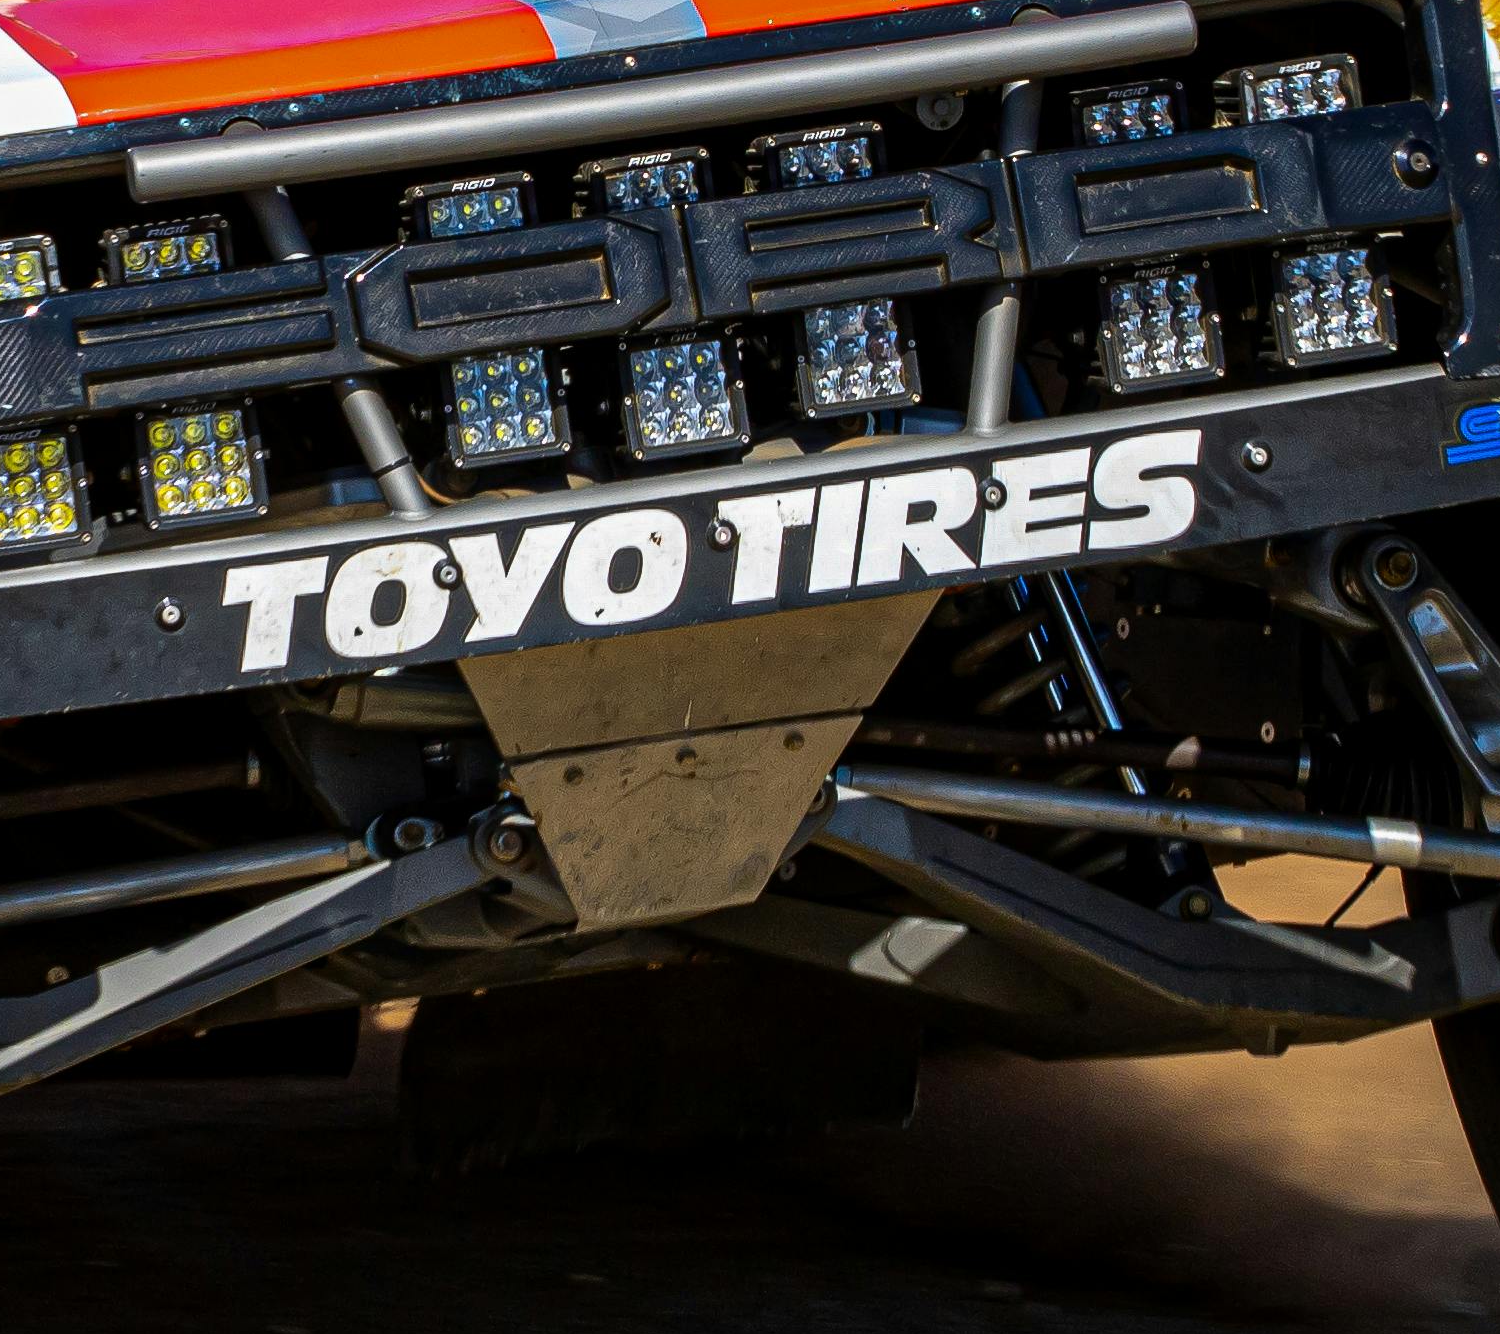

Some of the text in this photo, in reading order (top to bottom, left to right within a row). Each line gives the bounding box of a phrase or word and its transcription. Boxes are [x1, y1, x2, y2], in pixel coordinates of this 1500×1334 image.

[1107, 86, 1149, 99] RIGID
[803, 128, 847, 142] RIGID
[628, 152, 672, 167] RIGID
[451, 177, 496, 192] RIGID
[24, 121, 1330, 417] FORD
[220, 430, 1202, 674] TOYO TIRES
